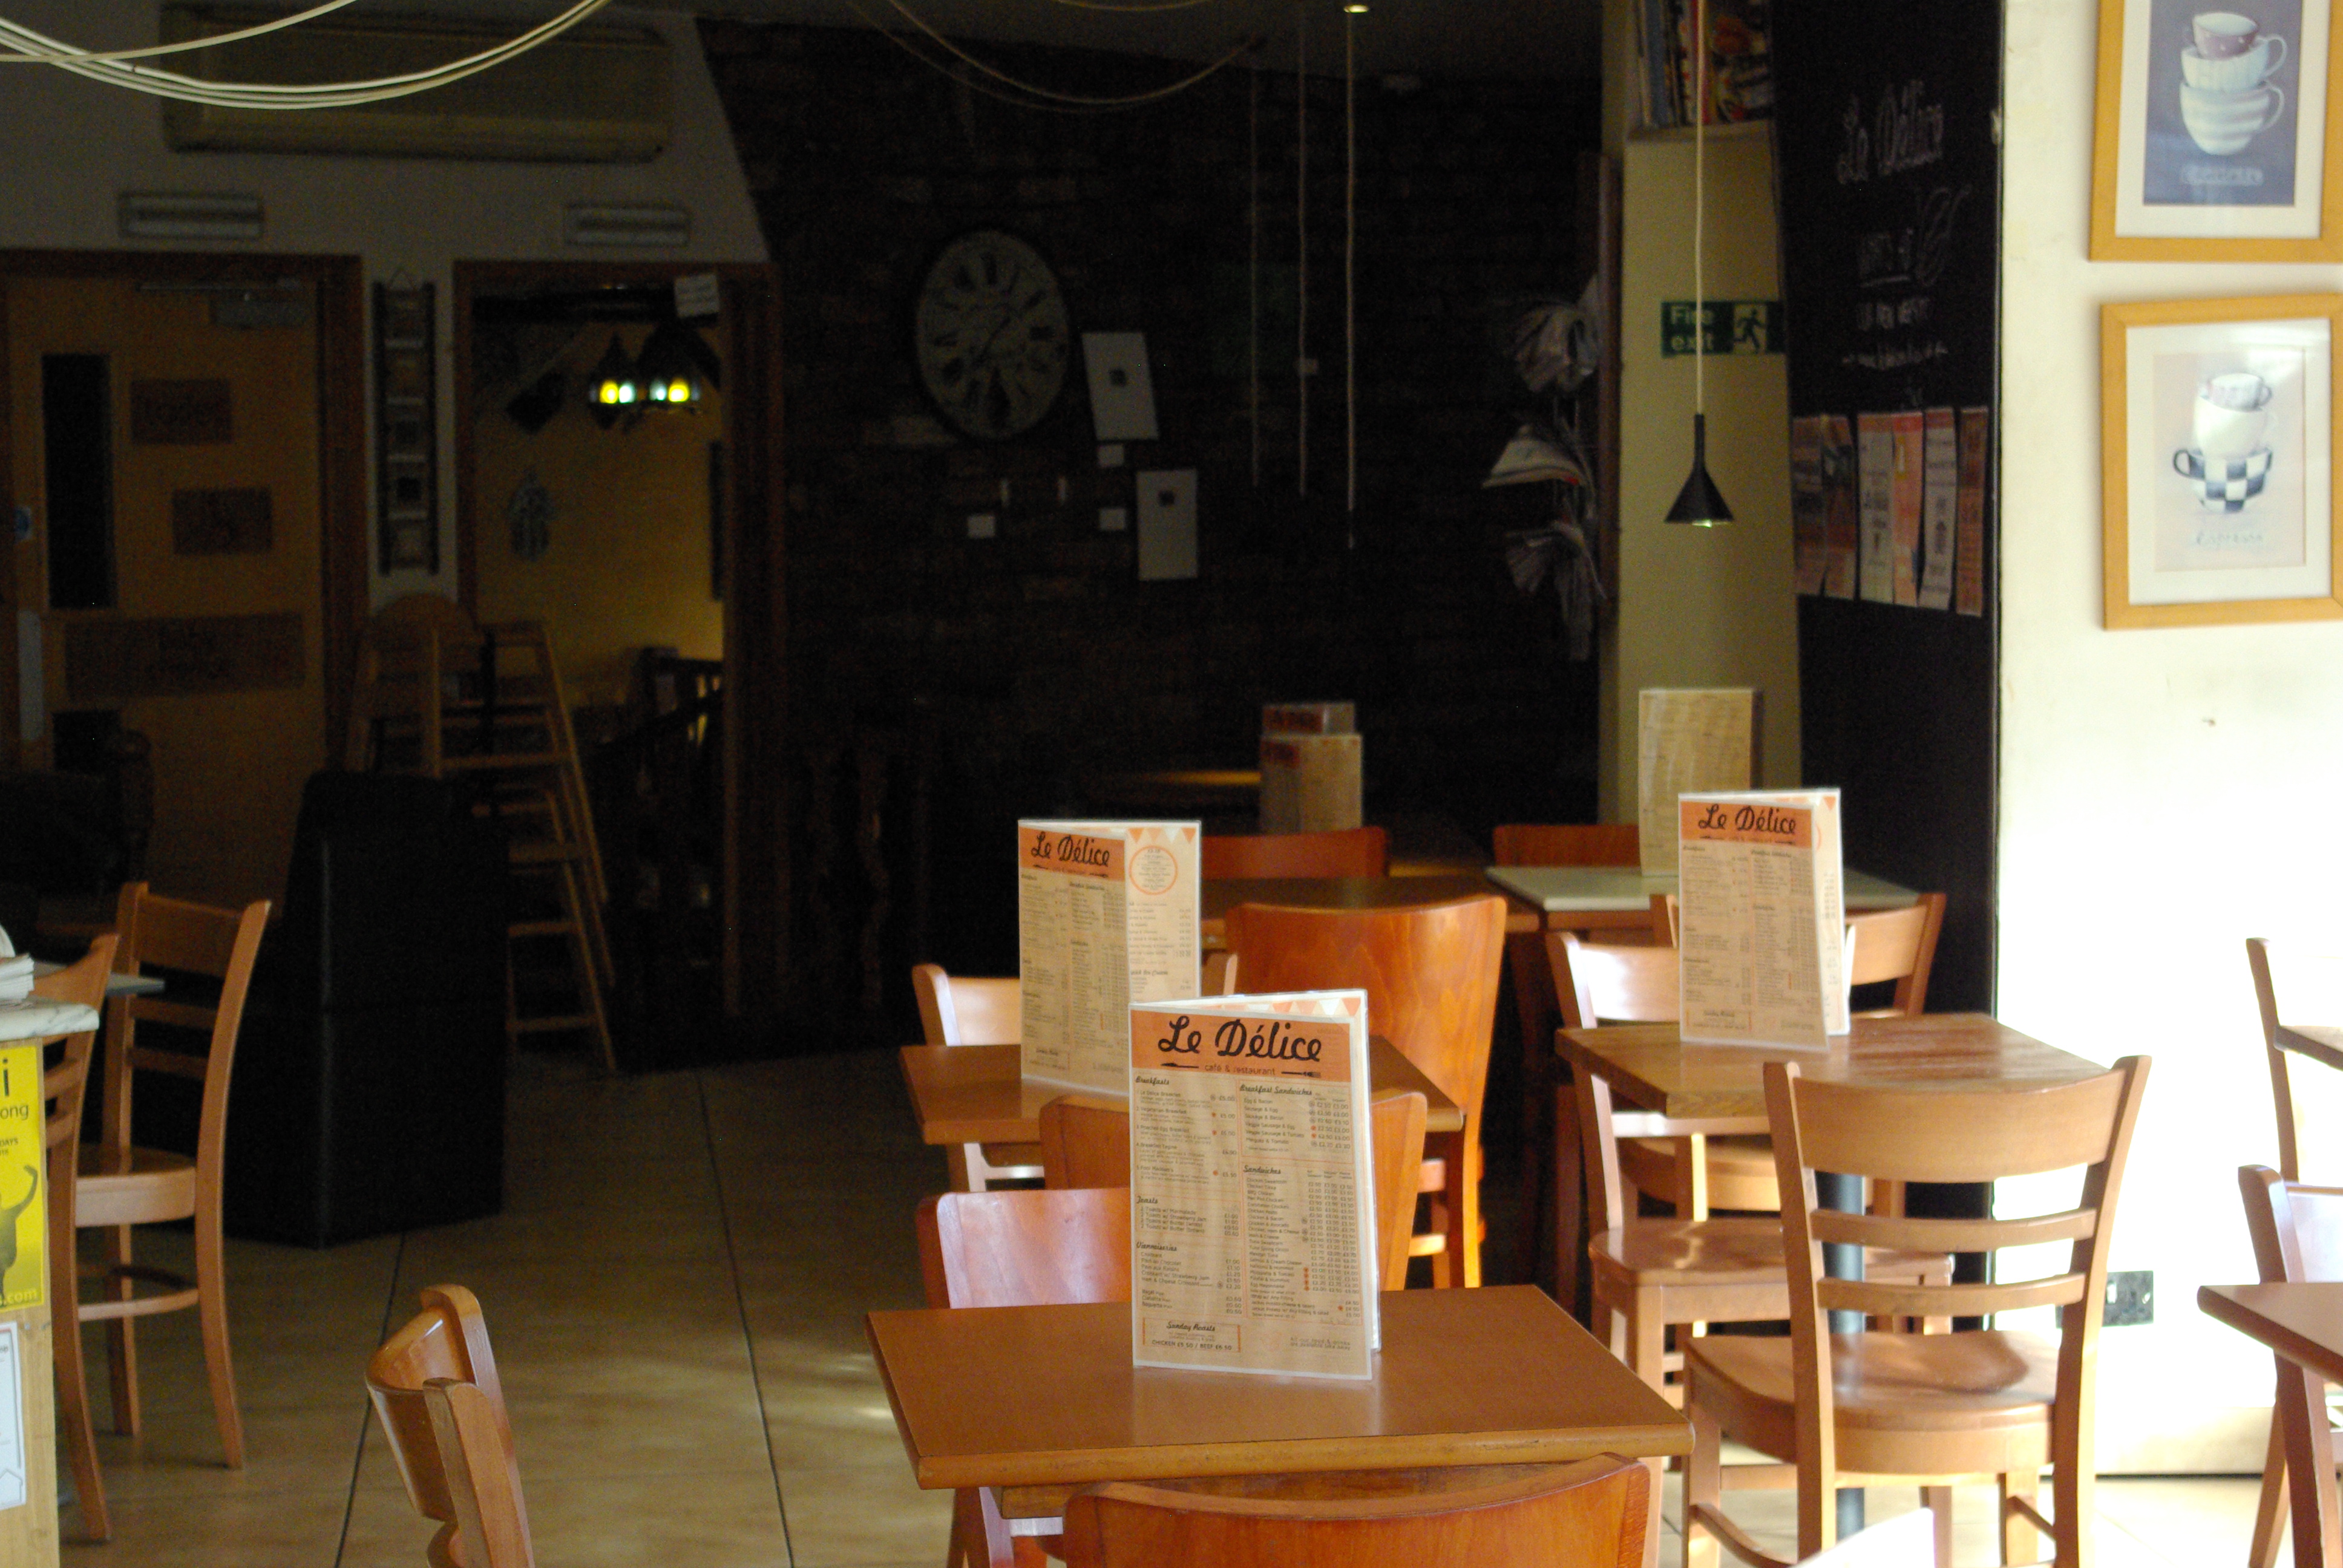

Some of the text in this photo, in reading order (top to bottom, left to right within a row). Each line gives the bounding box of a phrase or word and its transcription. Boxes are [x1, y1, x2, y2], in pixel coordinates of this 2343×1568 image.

[1698, 804, 1796, 834] Le Délice
[1031, 831, 1110, 867] Le Délice
[1158, 1015, 1322, 1061] Le Délice
[1205, 1062, 1276, 1076] café & restaurant
[1135, 1075, 1169, 1086] Breakfasts
[1239, 1083, 1312, 1096] Breakfast Sandwiches
[1243, 1164, 1281, 1174] Sandwiches
[1136, 1195, 1158, 1204] Toasts
[1136, 1241, 1177, 1252] Viennoiseries
[1167, 1321, 1215, 1331] Sunday Roasts
